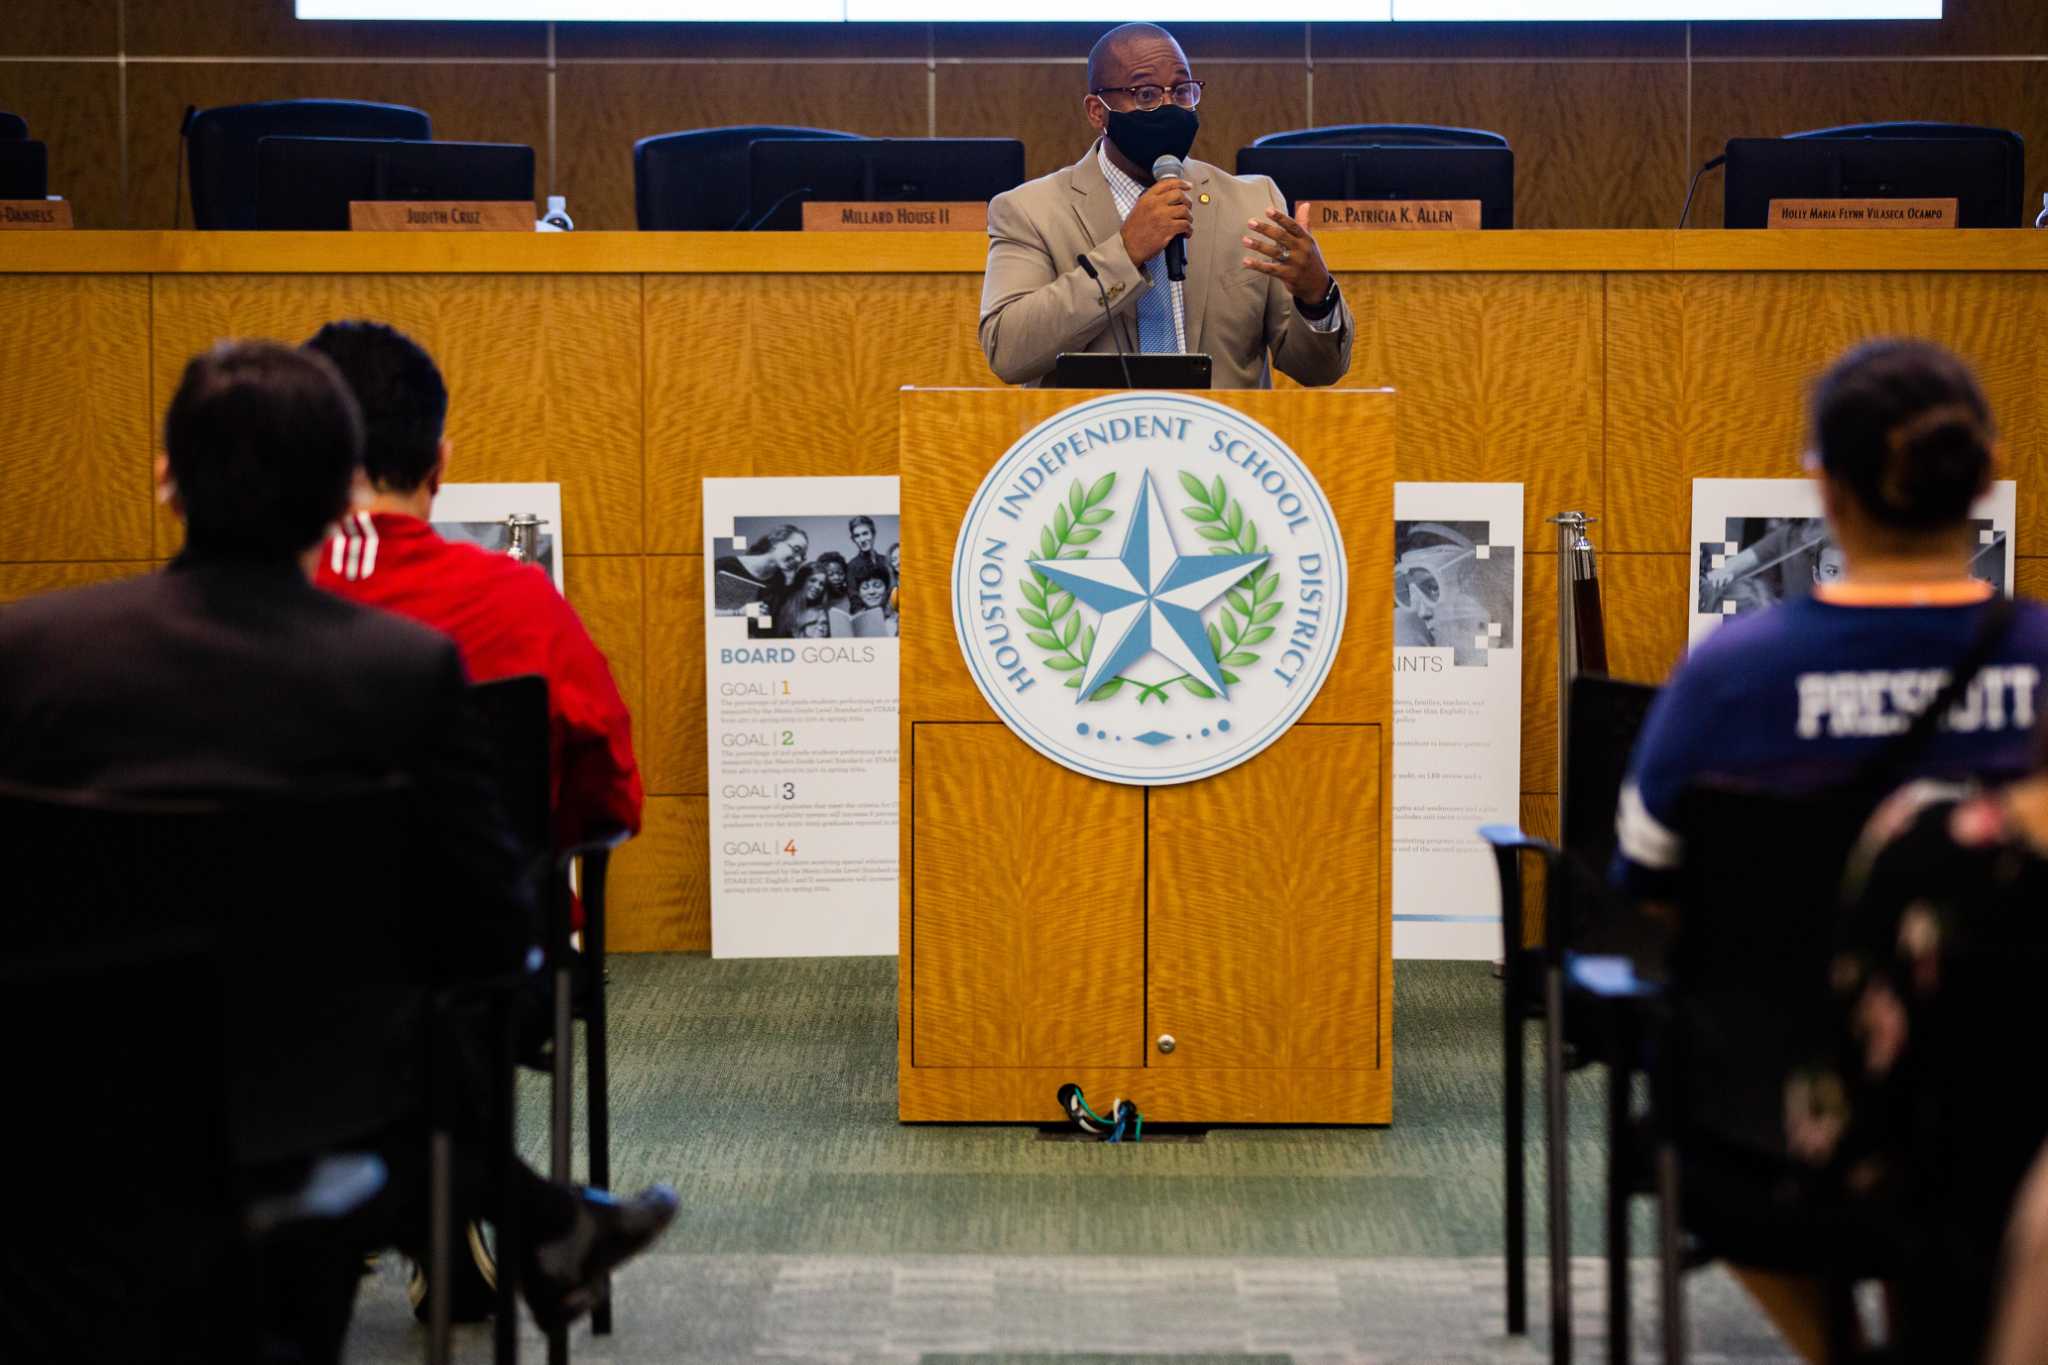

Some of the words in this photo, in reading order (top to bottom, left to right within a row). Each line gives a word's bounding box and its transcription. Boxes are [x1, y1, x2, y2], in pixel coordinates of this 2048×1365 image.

[407, 207, 448, 224] JUDITH
[451, 207, 481, 224] CRUZ
[842, 208, 893, 224] MILLARD
[897, 208, 936, 224] HOUSE
[1322, 207, 1342, 224] DR.
[1345, 207, 1396, 224] PATRICIA
[1400, 207, 1413, 224] K.
[1417, 207, 1453, 224] ALLEN
[1781, 207, 1806, 220] HOLLY
[1809, 207, 1836, 220] MARIA
[1839, 207, 1864, 220] FLYNN
[1907, 207, 1943, 220] OCAMPO
[996, 415, 1193, 521] INDEPENDENT
[1207, 429, 1313, 535] SCHOOL
[978, 536, 1038, 695] HOUSTON
[1272, 551, 1324, 689] DISTRICT
[720, 648, 796, 664] BOARD
[801, 646, 875, 664] GOALS
[720, 681, 768, 696] GOAL
[781, 680, 791, 695] 1
[721, 733, 769, 747] GOAL
[781, 730, 794, 746] 2
[722, 784, 770, 799] GOAL
[782, 782, 796, 800] 3
[723, 841, 771, 856] GOAL
[783, 839, 797, 857] 4
